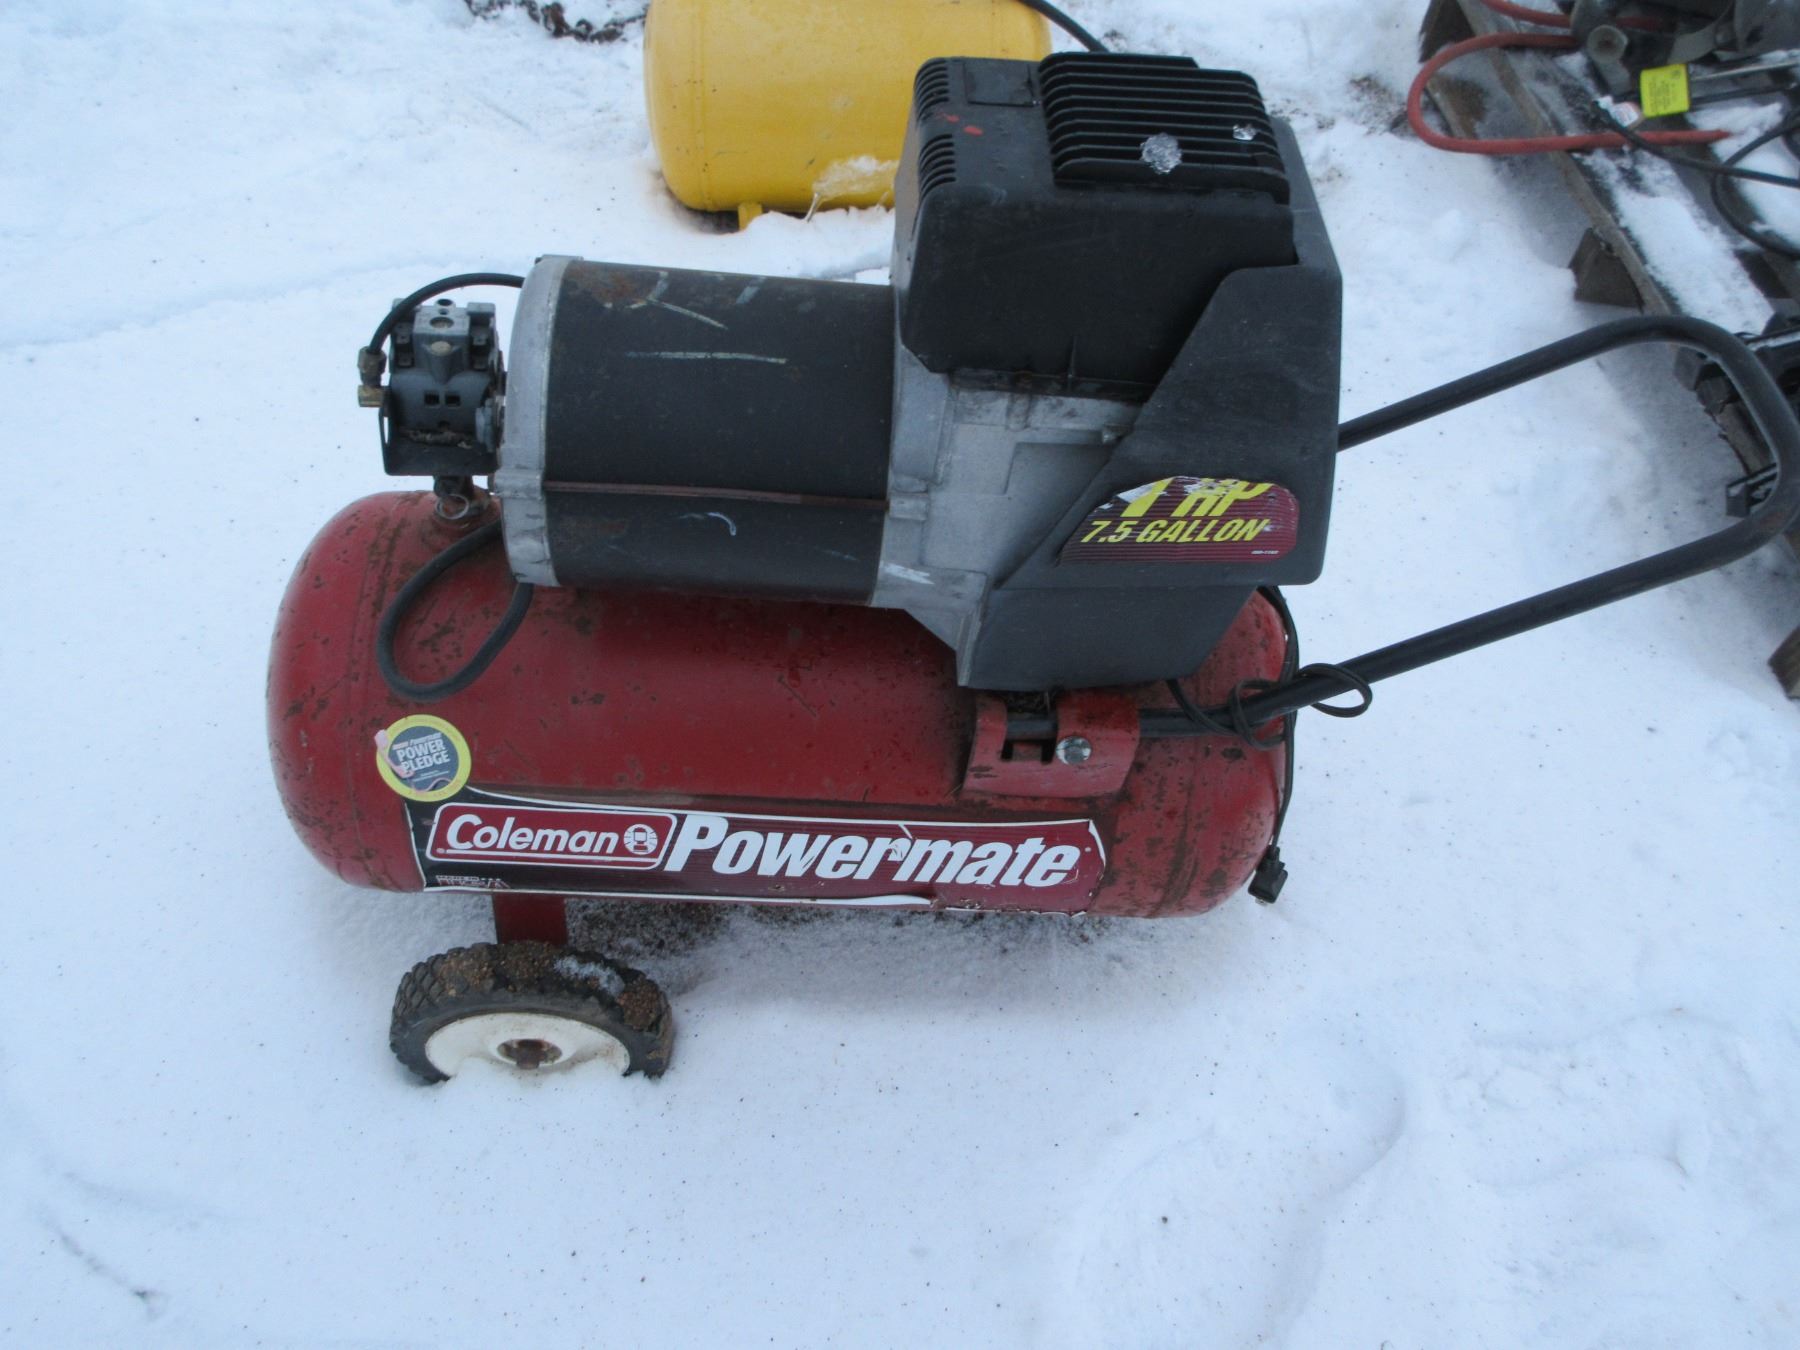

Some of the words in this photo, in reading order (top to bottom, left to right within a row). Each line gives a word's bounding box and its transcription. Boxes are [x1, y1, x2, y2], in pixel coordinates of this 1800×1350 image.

[1081, 520, 1138, 543] 7.5
[1135, 518, 1272, 543] GALLON
[396, 738, 446, 761] POWER
[401, 750, 451, 773] PLEDGE
[446, 813, 620, 854] Coleman
[663, 813, 1081, 888] Powermate
